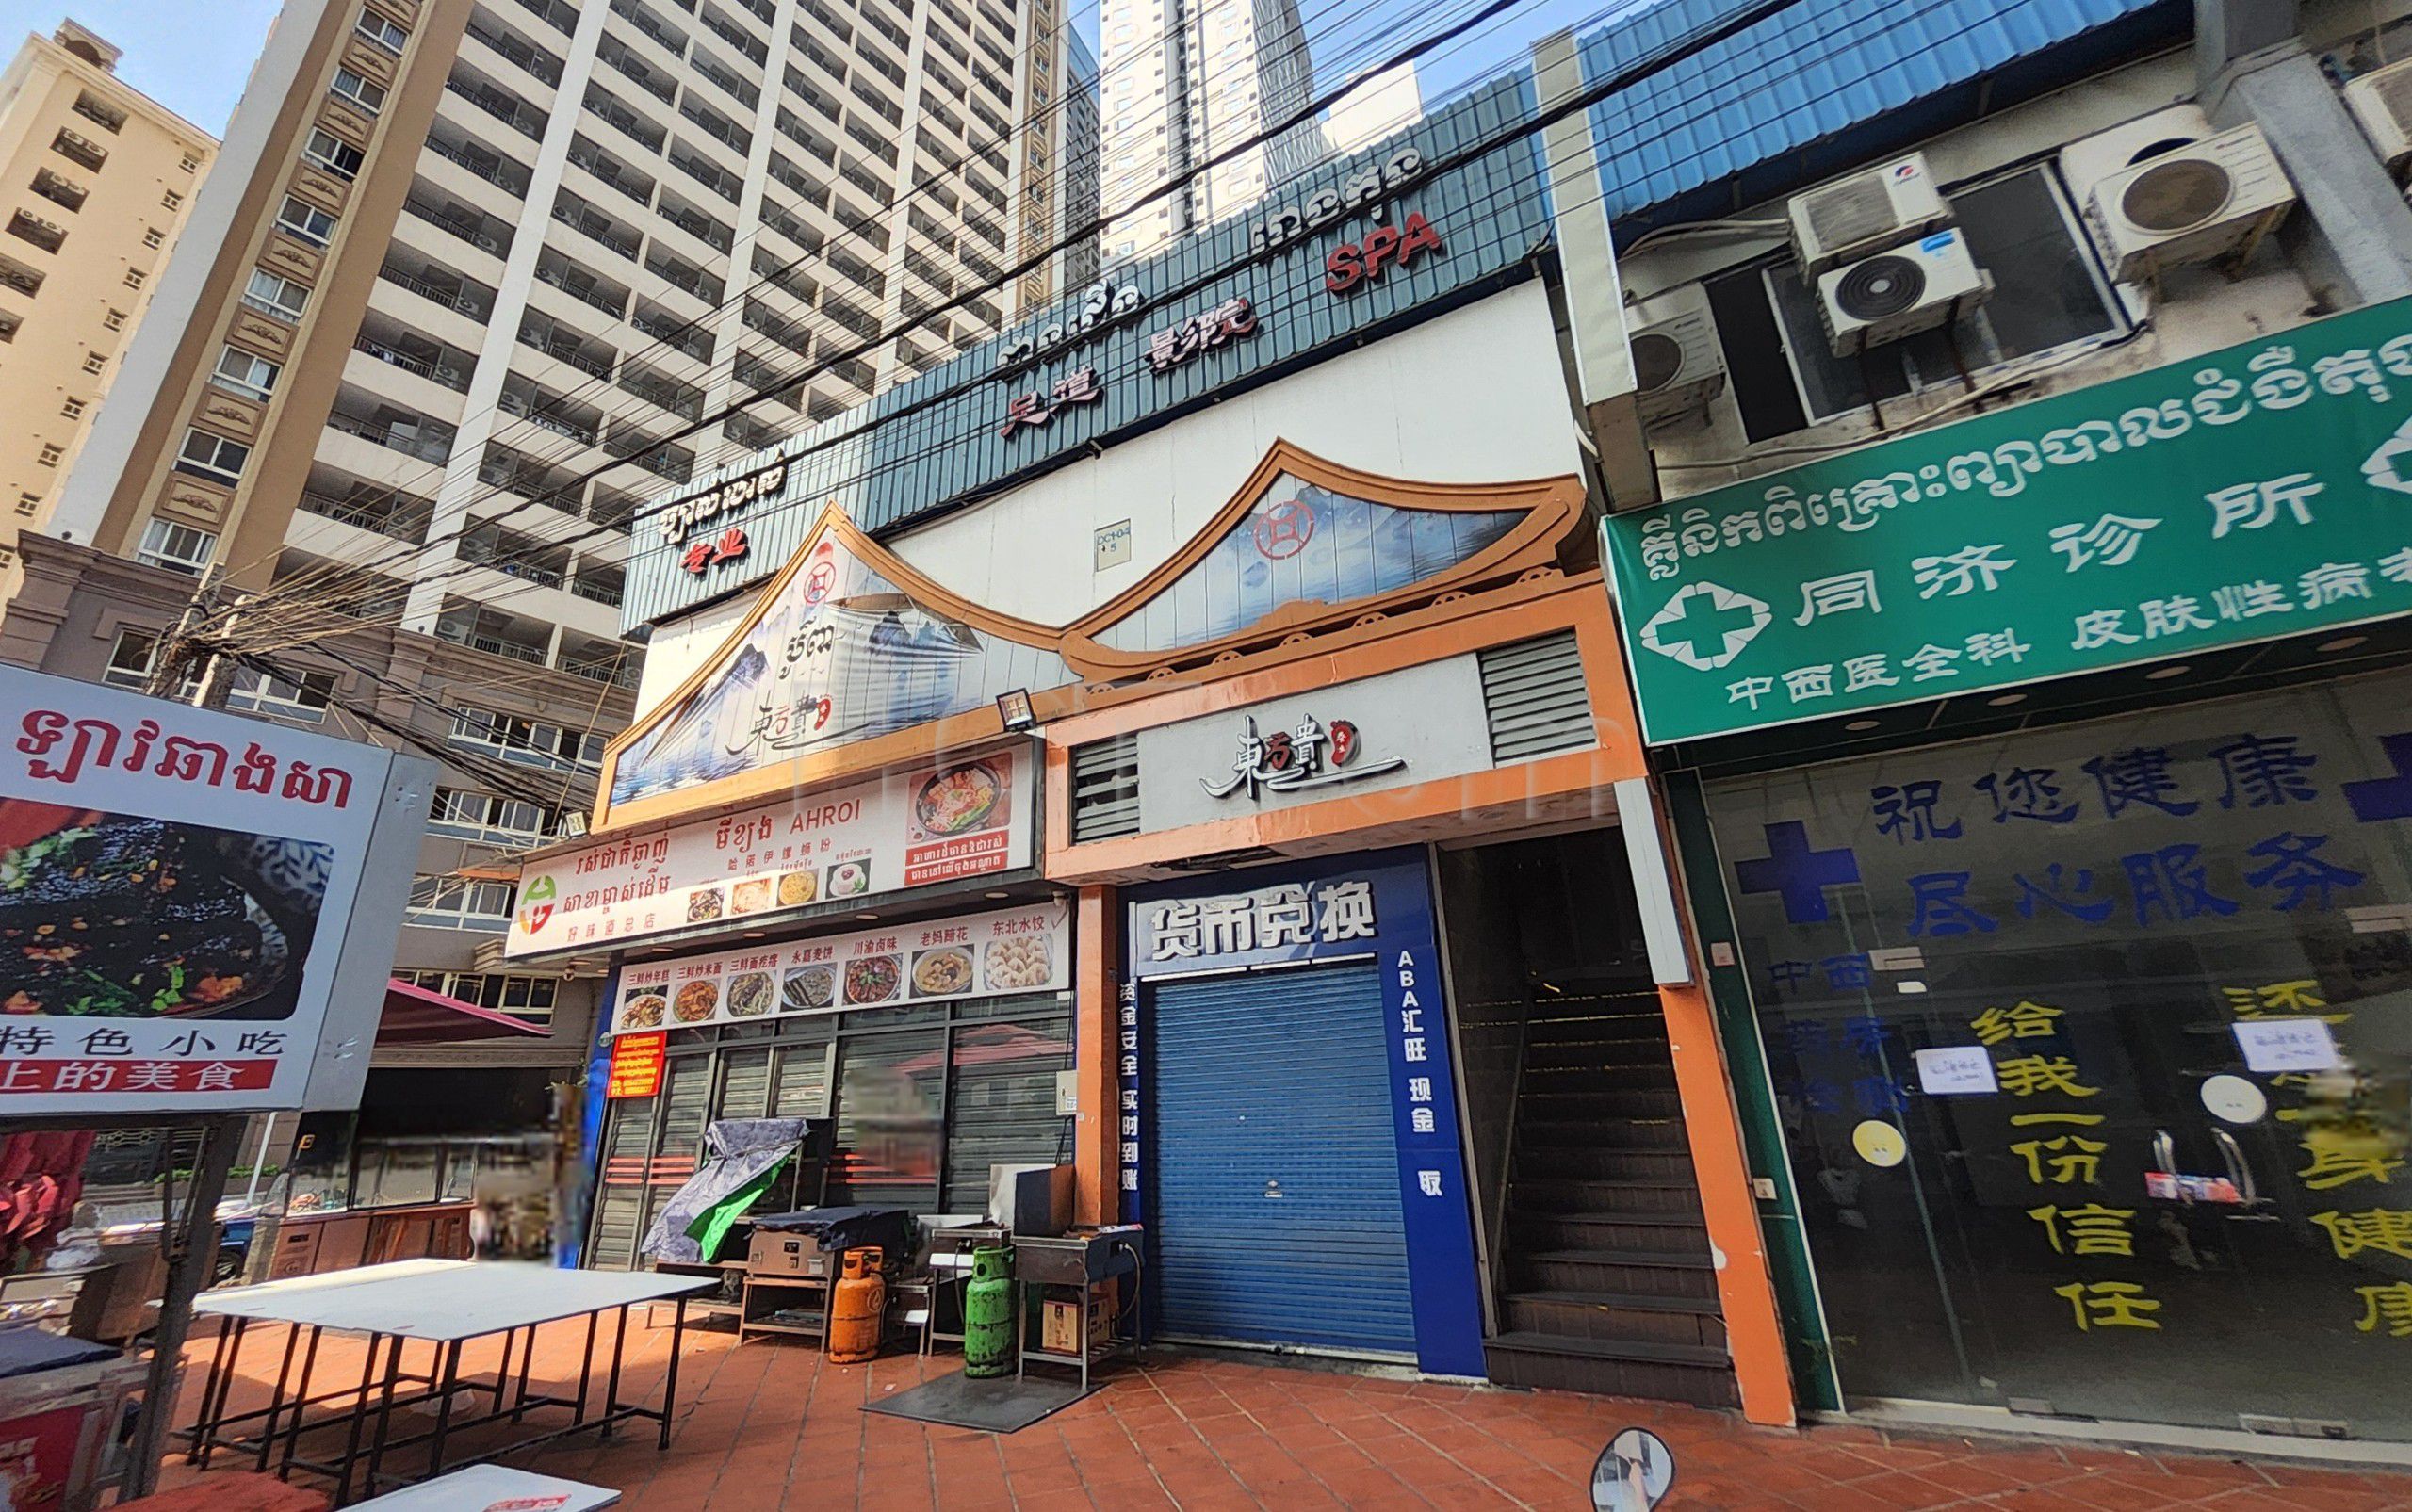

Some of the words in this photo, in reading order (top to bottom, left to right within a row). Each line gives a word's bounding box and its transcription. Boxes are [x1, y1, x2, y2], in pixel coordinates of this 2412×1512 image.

[1326, 211, 1442, 292] SPA
[1000, 364, 1100, 438] 足道
[1144, 297, 1257, 369] 影院
[679, 528, 748, 573] 专业
[1793, 471, 2325, 627] 同济诊所
[1725, 626, 2032, 712] 中西医全科
[16, 708, 353, 809] ឡាវឆាងសា
[1870, 733, 2321, 845] 祝您健康
[790, 798, 861, 835] AHROI
[1150, 879, 1378, 962] 货币兑换
[1906, 831, 2370, 937] 尽心服务
[729, 953, 780, 973] 三鲜面疙瘩
[853, 935, 898, 956] 川渝卤味
[920, 925, 969, 947] 老妈蹄花
[991, 915, 1046, 937] 东北水饺
[1970, 1000, 2162, 1332] 给我一份信任
